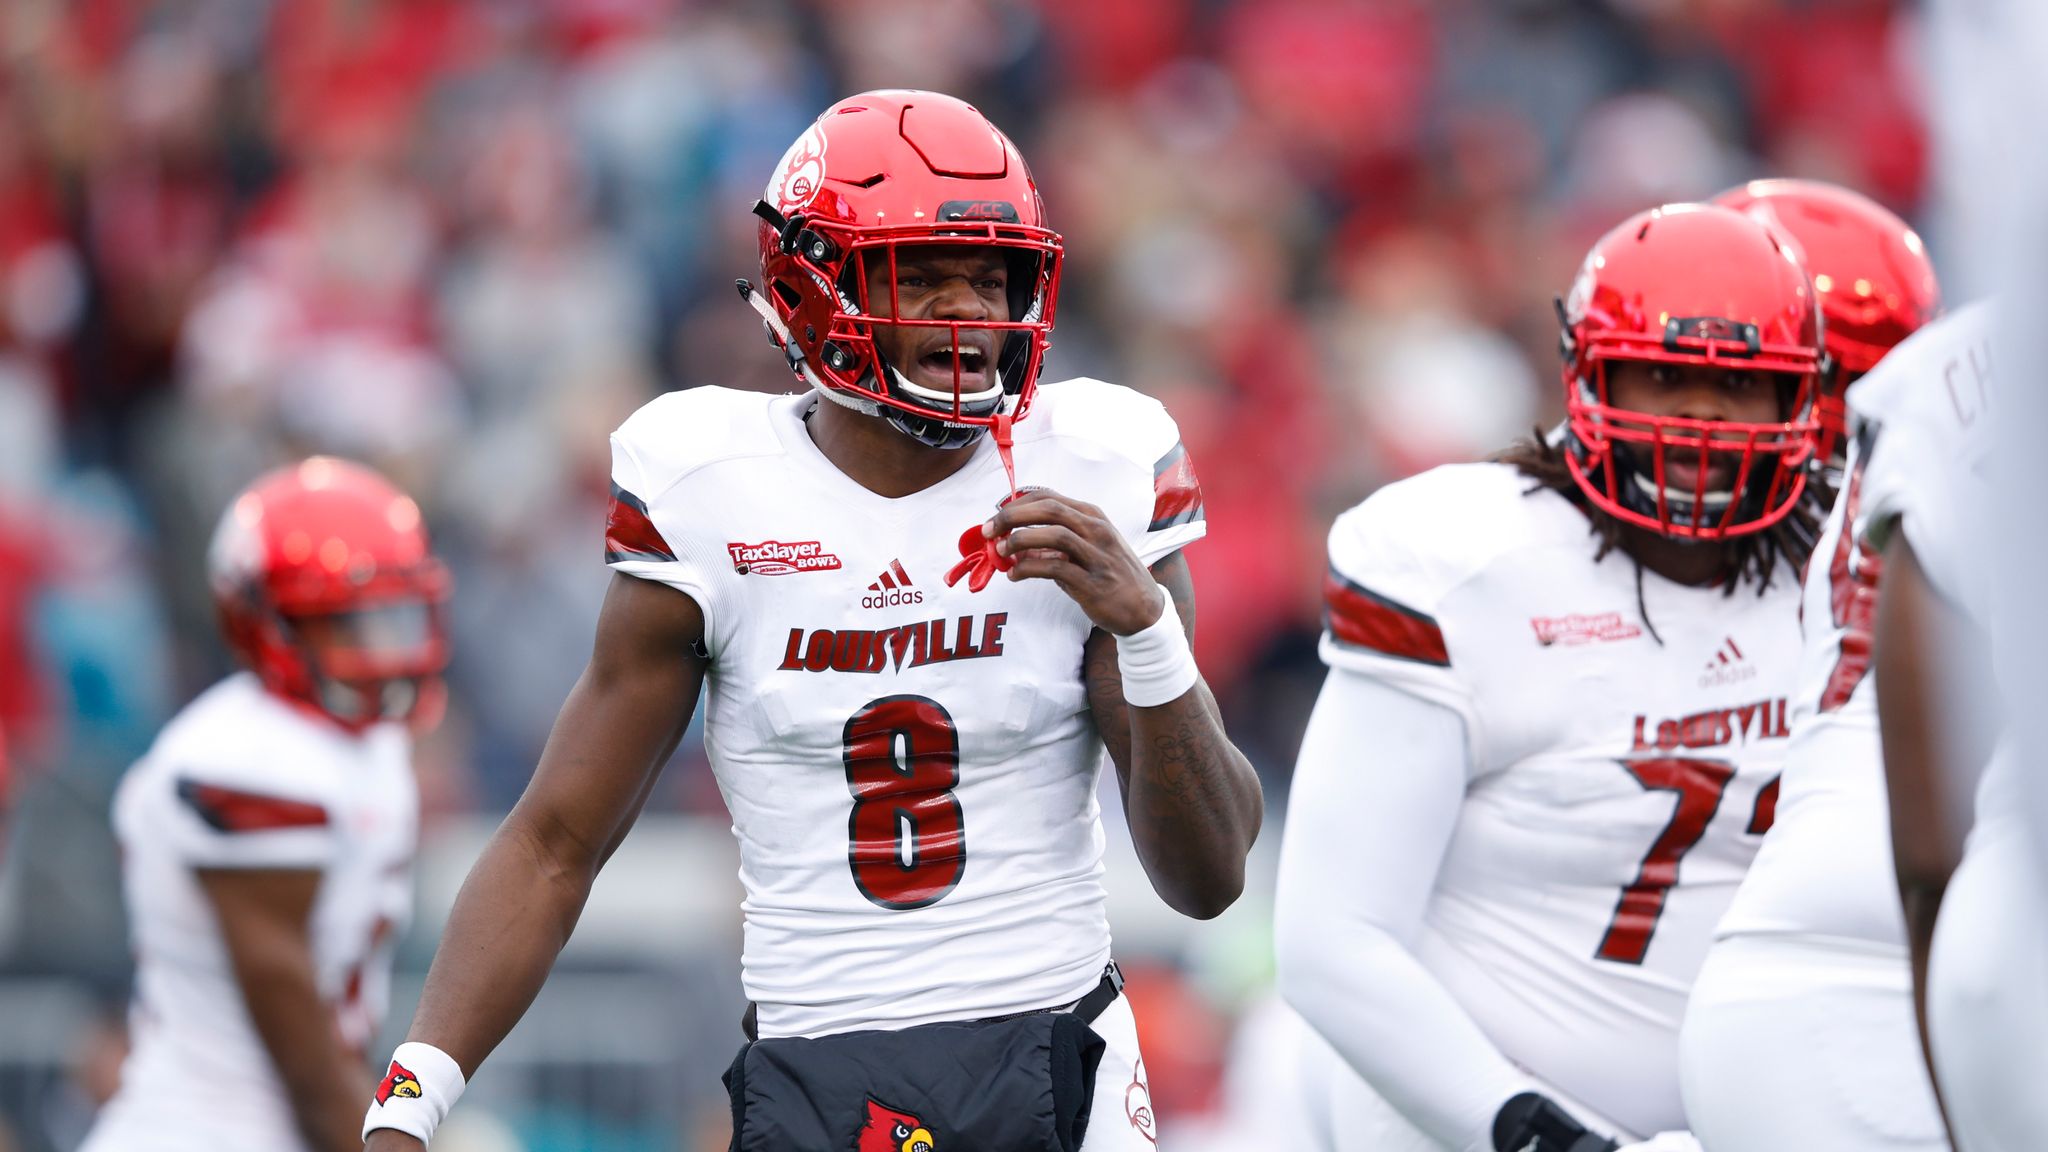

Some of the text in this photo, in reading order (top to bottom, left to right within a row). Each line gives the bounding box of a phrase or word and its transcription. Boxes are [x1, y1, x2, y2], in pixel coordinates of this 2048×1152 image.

[962, 203, 1004, 217] ACC
[730, 543, 819, 562] TaxSlayer
[797, 556, 838, 568] BOWL
[862, 588, 923, 609] adidas
[777, 612, 1008, 675] LOUISVILLE
[1632, 697, 1791, 751] LOUISVIL
[842, 693, 966, 910] 8
